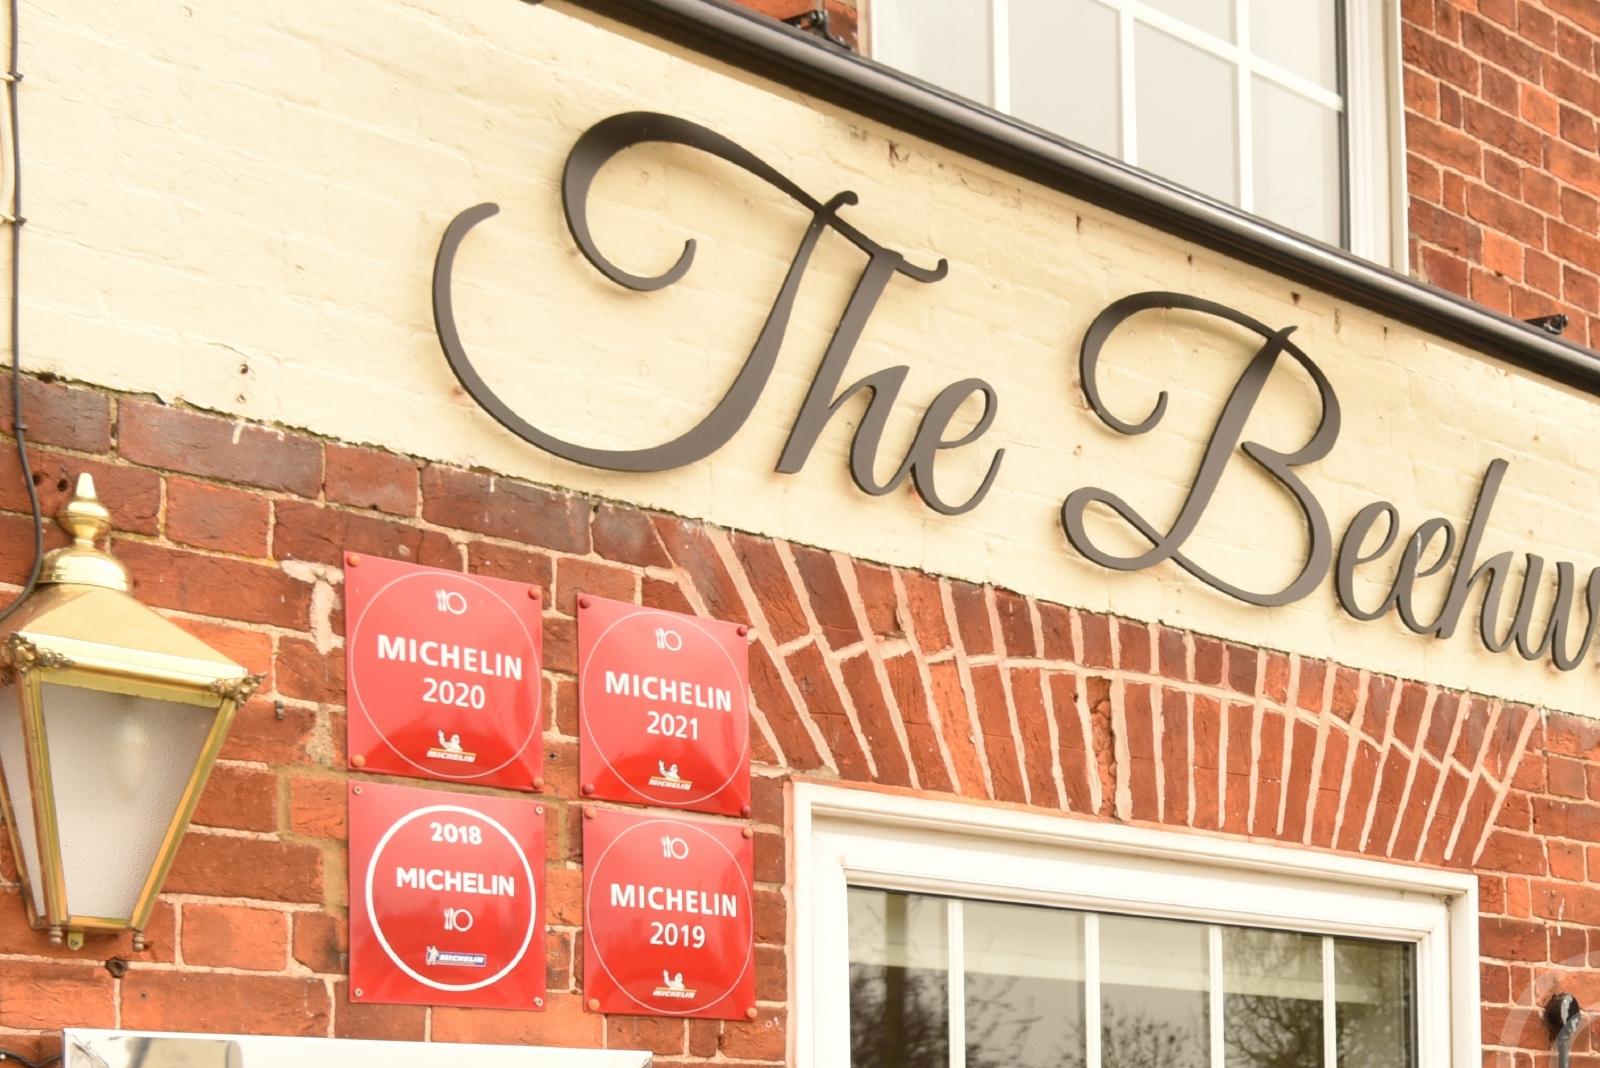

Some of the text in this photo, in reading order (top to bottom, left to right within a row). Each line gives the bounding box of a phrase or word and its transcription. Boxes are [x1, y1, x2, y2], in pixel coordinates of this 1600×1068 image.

[431, 110, 1006, 516] The
[377, 634, 523, 681] MICHELIN
[422, 678, 486, 710] 2020
[605, 670, 733, 713] MICHELIN
[646, 710, 700, 741] 2021
[429, 822, 483, 846] 2018
[395, 866, 516, 898] MICHELIN
[610, 882, 738, 919] MICHELIN
[649, 921, 707, 949] 2019
